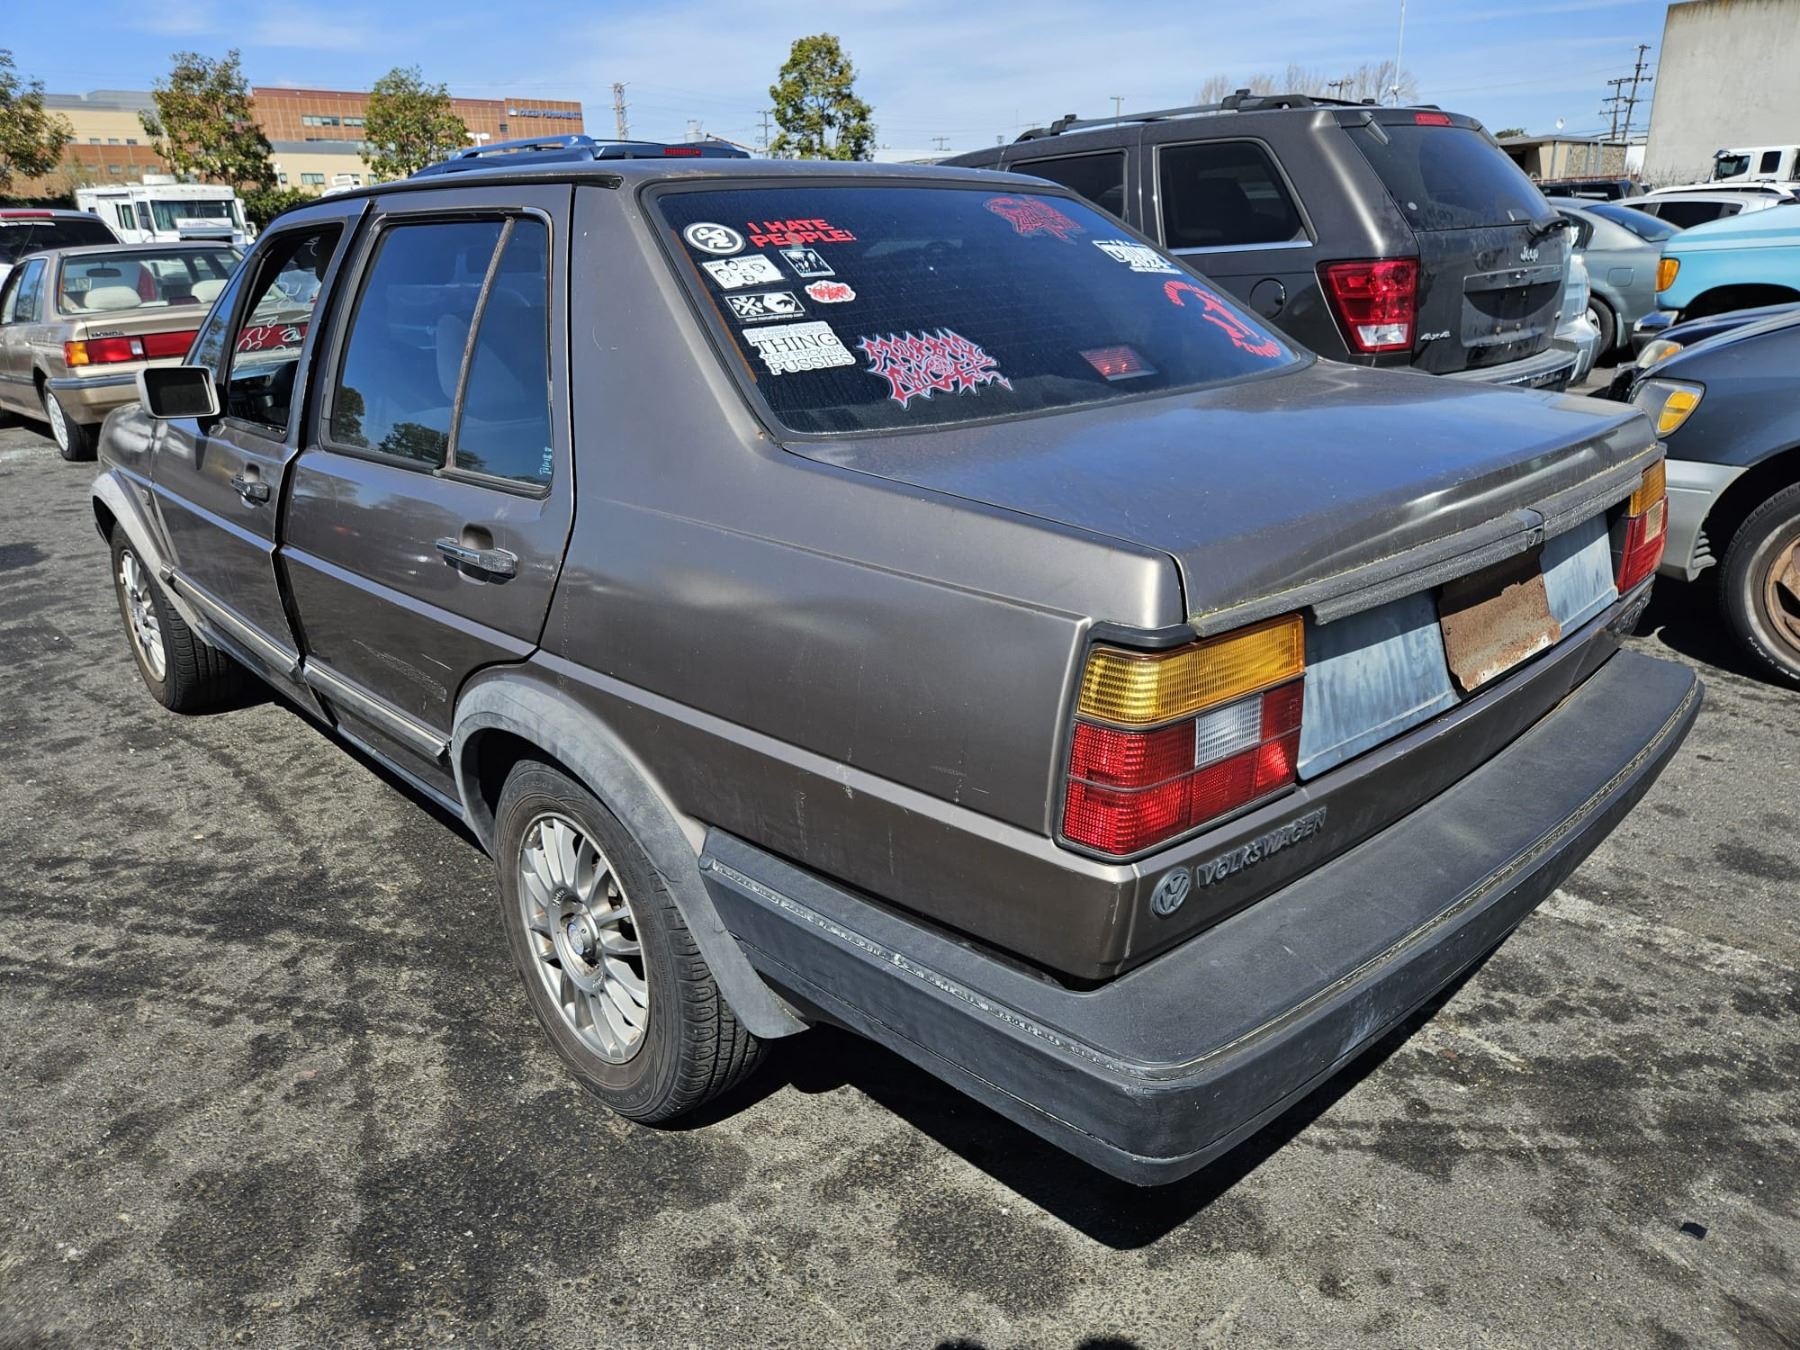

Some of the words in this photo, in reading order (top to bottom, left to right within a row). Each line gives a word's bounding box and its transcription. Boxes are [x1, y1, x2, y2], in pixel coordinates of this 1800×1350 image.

[746, 222, 762, 234] I
[763, 219, 834, 233] HATE
[749, 229, 857, 248] PEOPLE!
[1520, 246, 1539, 262] Jeep
[752, 333, 839, 354] THING
[764, 352, 790, 363] YOU
[794, 345, 846, 358] FUCKING
[768, 354, 854, 374] PUSSIES
[1200, 805, 1328, 887] VOLKSWAGEN
